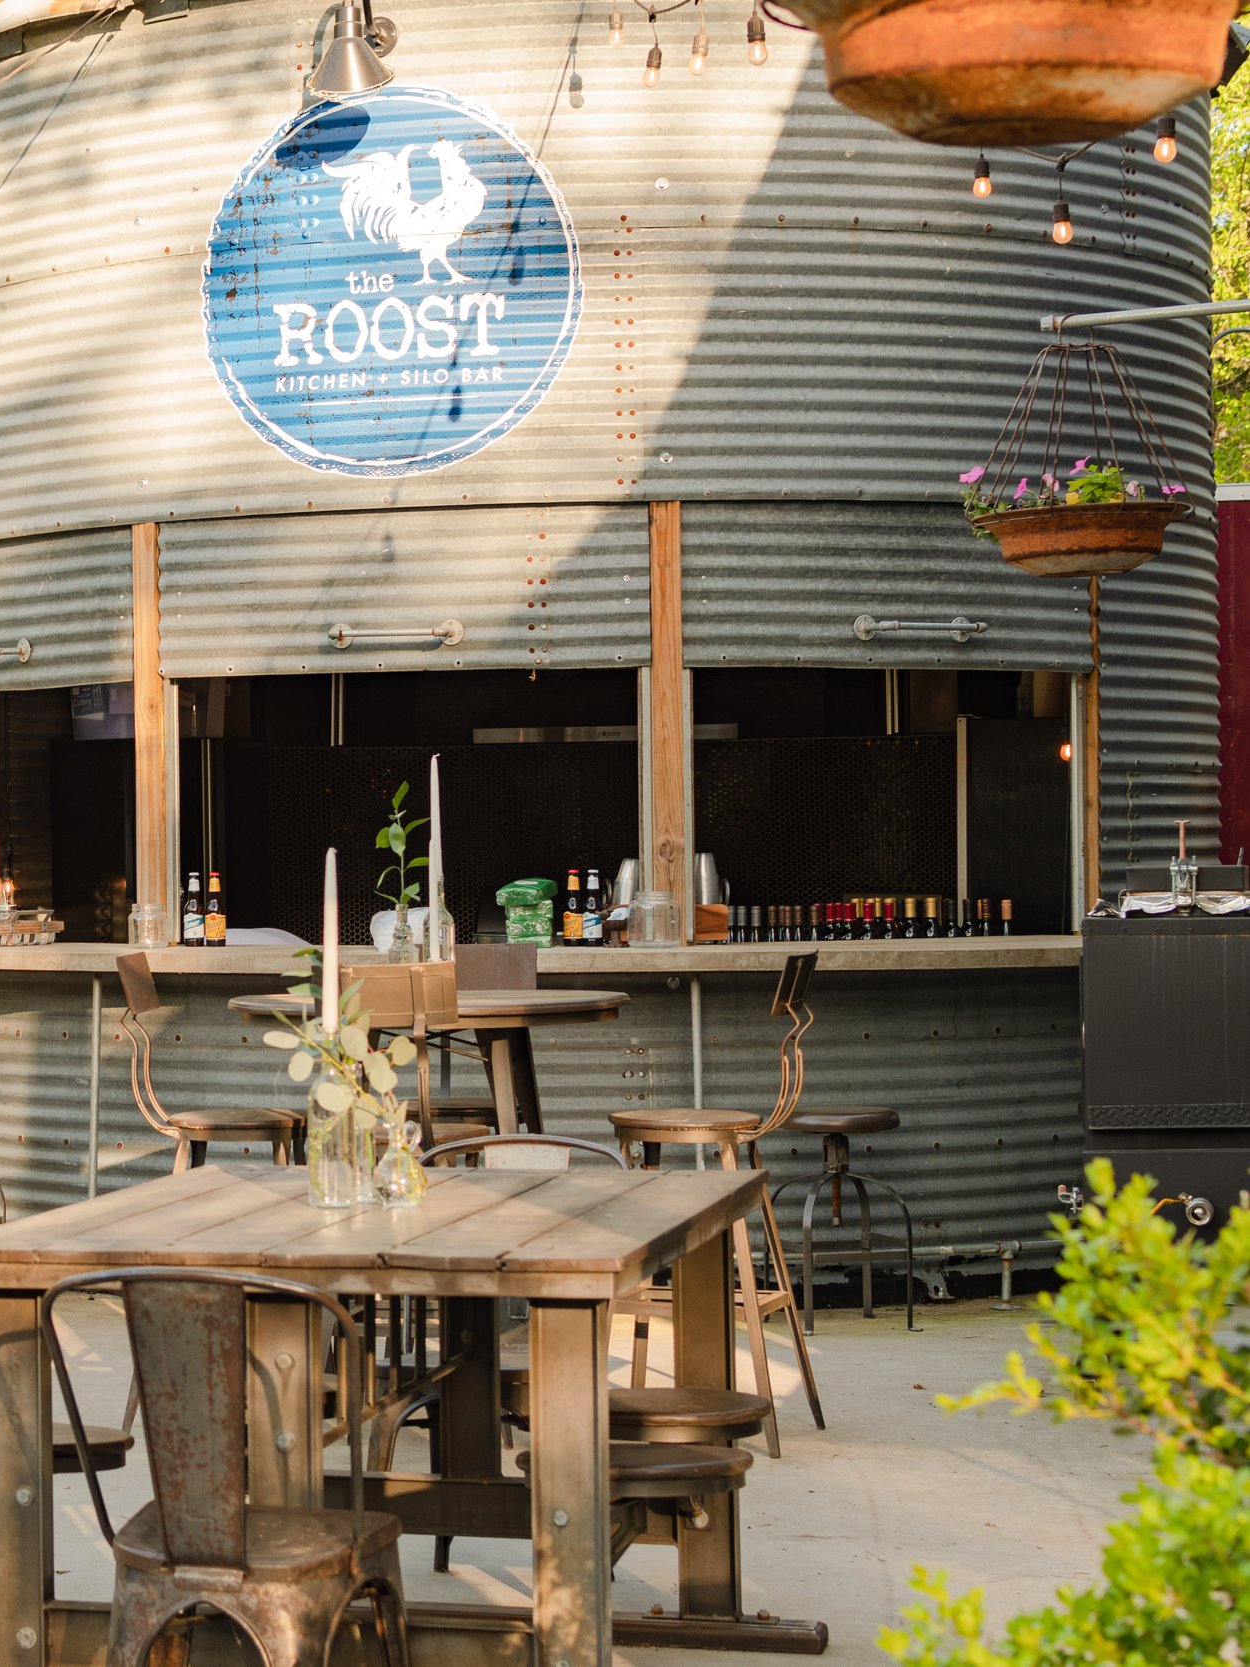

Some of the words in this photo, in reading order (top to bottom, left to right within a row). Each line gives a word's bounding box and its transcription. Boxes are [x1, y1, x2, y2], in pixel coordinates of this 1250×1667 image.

[345, 270, 394, 295] the
[272, 292, 506, 367] ROOST
[275, 371, 366, 393] KITCHEN
[400, 368, 449, 385] SILO
[461, 366, 503, 383] BAR
